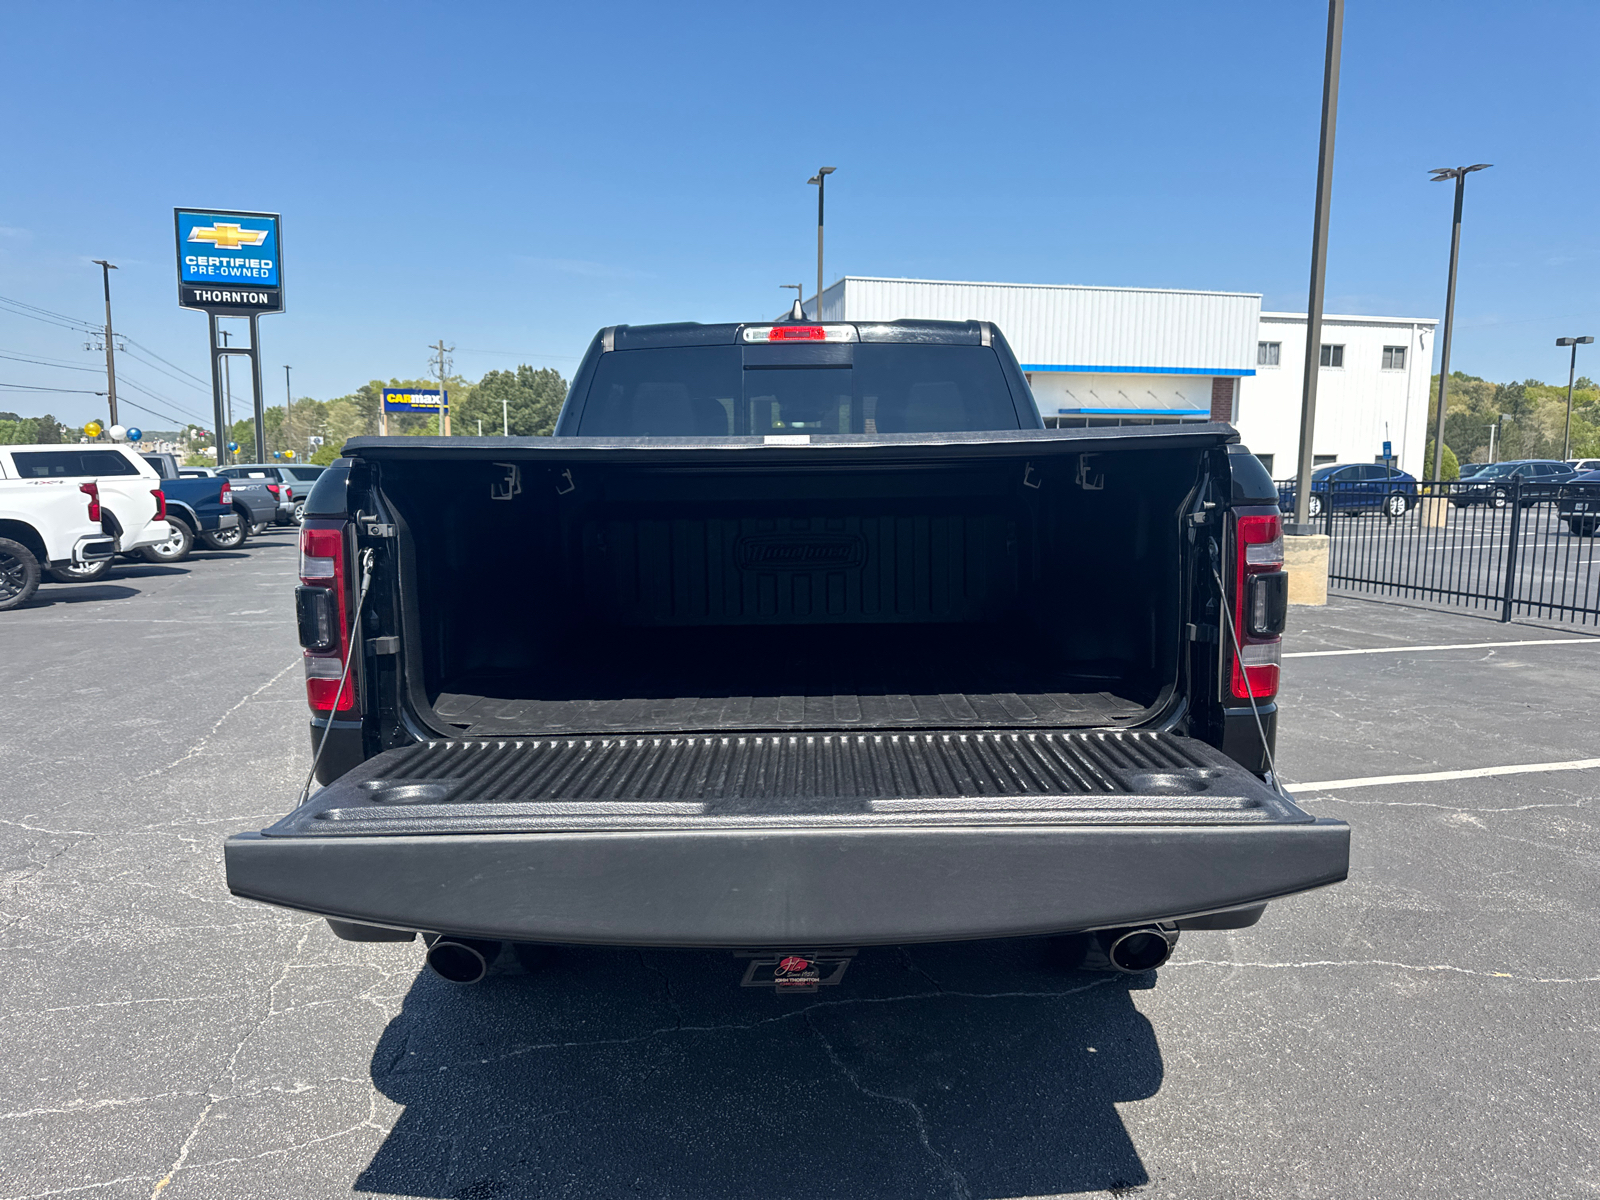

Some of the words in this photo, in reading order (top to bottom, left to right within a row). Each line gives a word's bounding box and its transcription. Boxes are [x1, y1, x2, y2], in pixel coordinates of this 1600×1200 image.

[185, 256, 273, 269] CERTIFIED
[190, 266, 269, 278] PRE-OWNED
[194, 290, 268, 304] THORNTON
